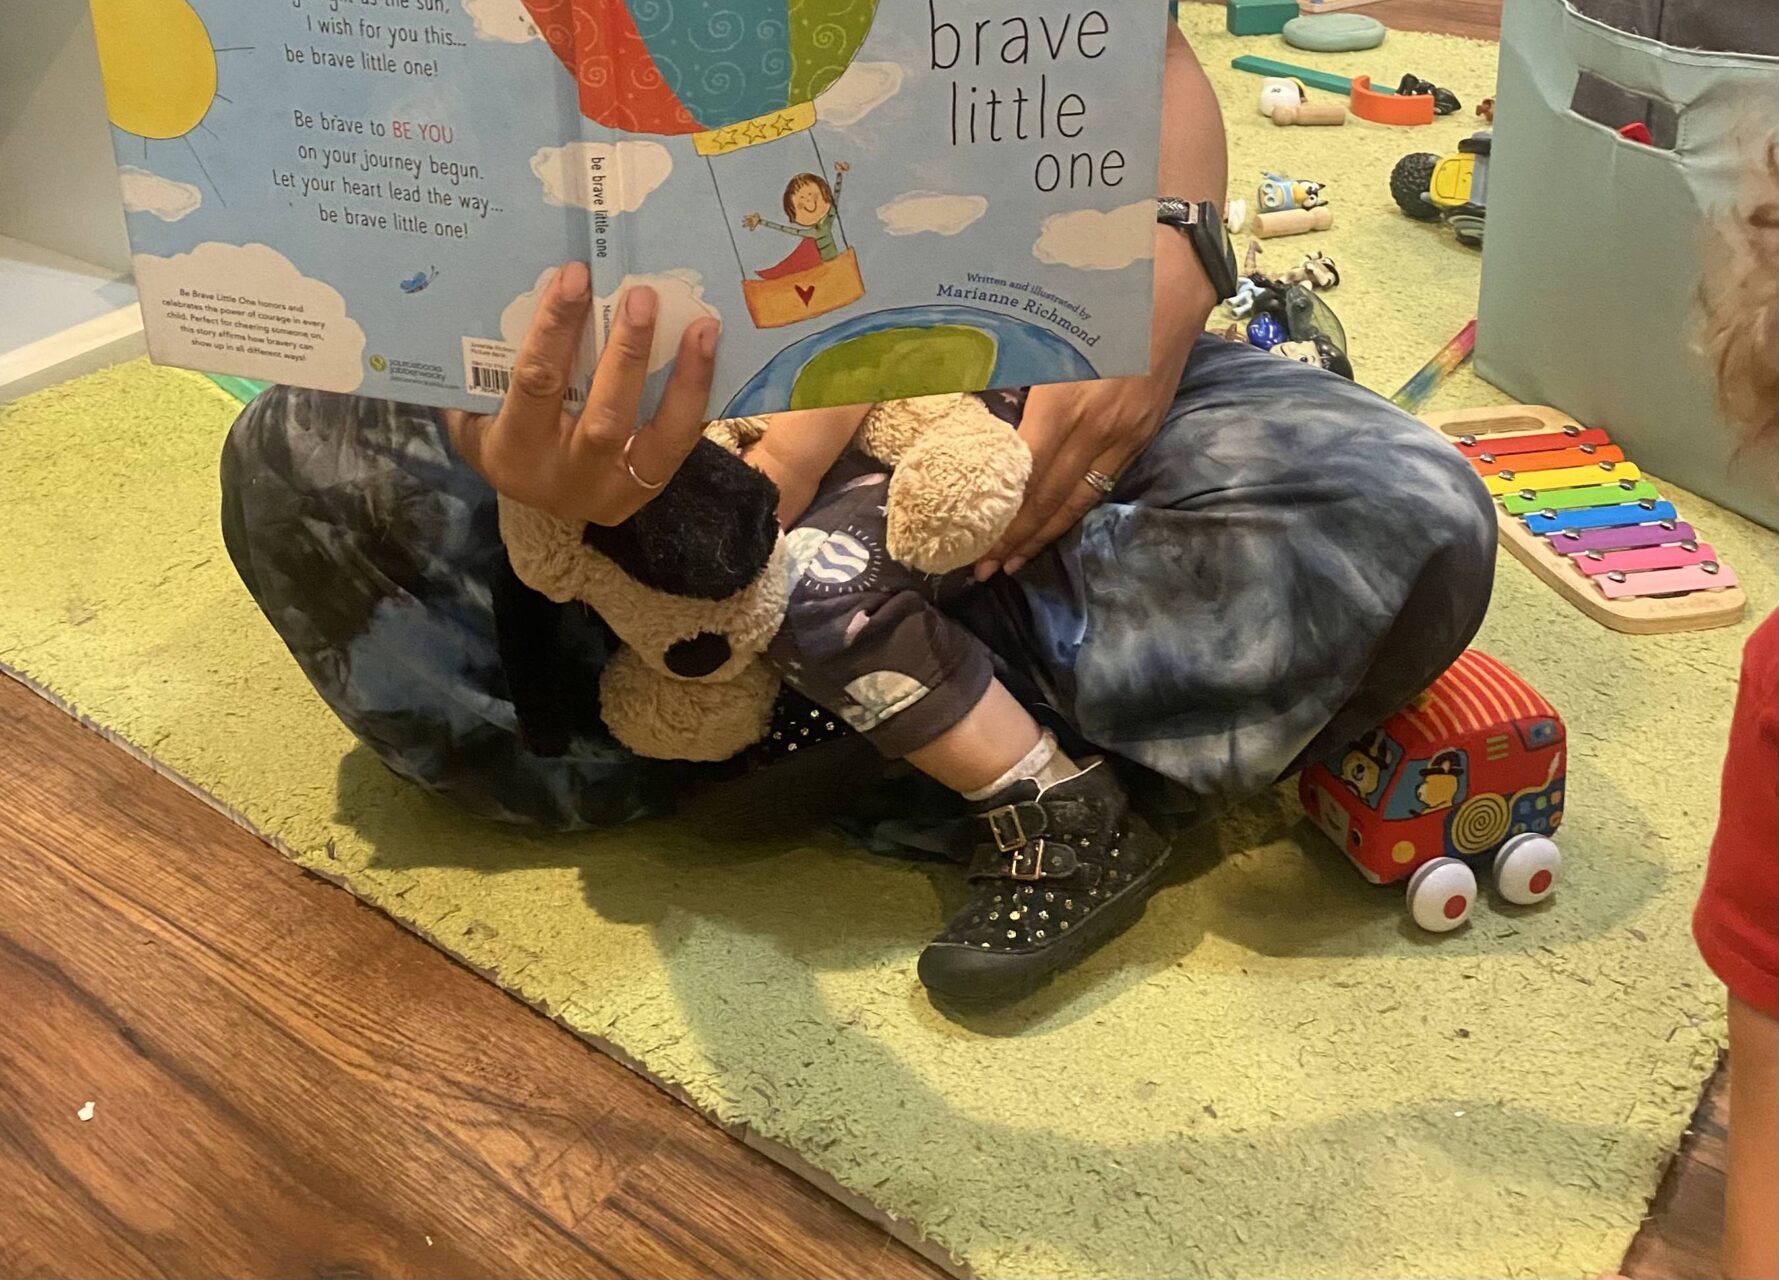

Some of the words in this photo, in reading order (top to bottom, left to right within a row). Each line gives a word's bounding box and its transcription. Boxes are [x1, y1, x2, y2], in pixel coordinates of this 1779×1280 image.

[306, 15, 311, 32] I
[317, 16, 353, 36] wish
[359, 18, 381, 39] for
[388, 26, 418, 49] you
[424, 26, 467, 47] this...
[929, 0, 1108, 70] brave
[284, 43, 304, 63] be
[310, 46, 355, 69] brave
[361, 52, 397, 73] little
[403, 59, 439, 77] one!
[293, 109, 314, 128] Be
[320, 112, 364, 135] brave
[370, 117, 386, 137] to
[392, 121, 413, 140] BE
[418, 123, 454, 144] YOU
[952, 74, 1086, 146] little
[298, 144, 317, 161] on
[322, 146, 357, 169] your
[360, 149, 423, 179] journey
[591, 157, 605, 171] be
[1034, 150, 1125, 192] one
[272, 169, 295, 189] Let
[301, 175, 336, 197] your
[343, 176, 383, 199] heart
[388, 182, 421, 203] lead
[427, 186, 452, 207] the
[458, 194, 504, 218] way...
[592, 175, 607, 206] brave
[318, 204, 338, 223] be
[344, 207, 387, 229] brave
[393, 212, 428, 234] little
[435, 221, 468, 239] one!
[595, 210, 607, 235] little
[596, 238, 607, 259] one
[192, 289, 214, 300] Brave
[238, 296, 256, 305] One
[967, 272, 1007, 287] Written
[1009, 280, 1029, 292] and
[1030, 284, 1080, 312] illustrated
[1078, 306, 1092, 321] by
[190, 313, 219, 325] Perfect
[220, 308, 245, 317] power
[258, 313, 291, 324] courage
[303, 319, 325, 330] every
[936, 283, 1019, 308] Marianne
[1022, 298, 1101, 347] Richmond
[196, 328, 216, 337] story
